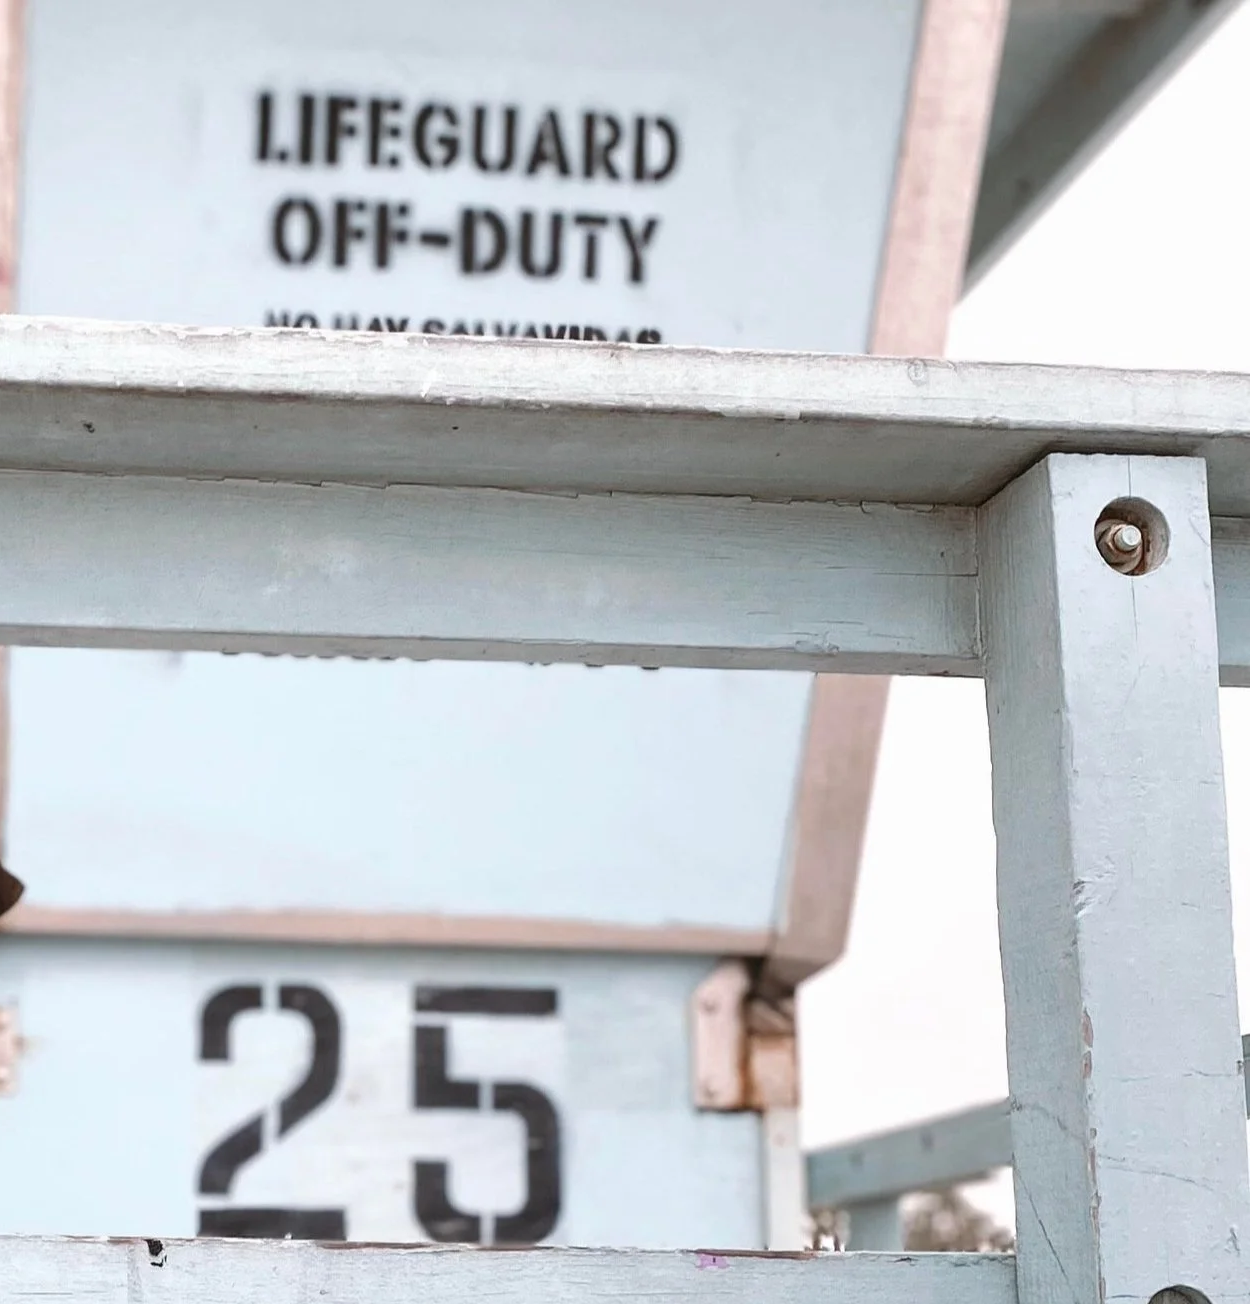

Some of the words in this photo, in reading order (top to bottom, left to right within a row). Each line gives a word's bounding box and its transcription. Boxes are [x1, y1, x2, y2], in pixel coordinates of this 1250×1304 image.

[254, 89, 681, 185] LIFEGUARD
[270, 195, 661, 285] OFF-DUTY
[195, 983, 564, 1244] 25
